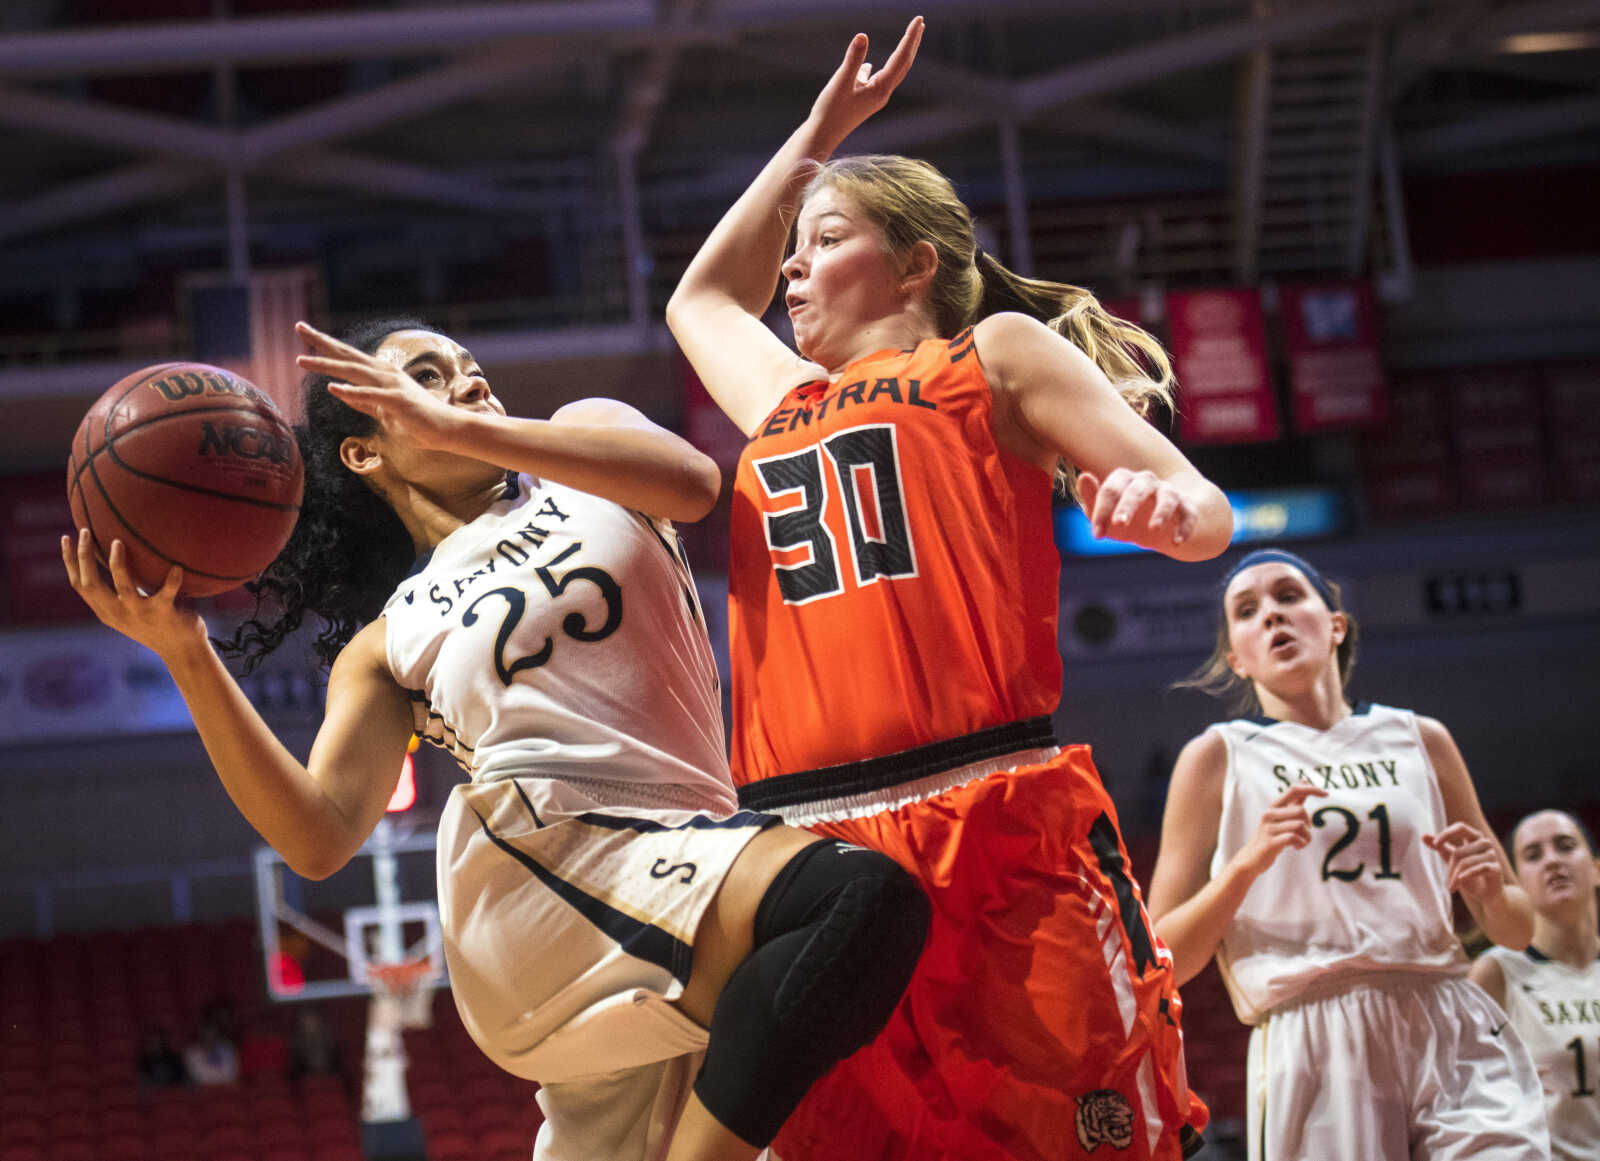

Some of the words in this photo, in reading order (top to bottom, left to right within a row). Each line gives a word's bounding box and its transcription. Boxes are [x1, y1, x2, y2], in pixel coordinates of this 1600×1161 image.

[149, 372, 270, 407] Wil
[749, 378, 936, 442] ENTRAL
[752, 424, 919, 606] 30
[462, 542, 623, 687] 25
[1273, 760, 1400, 793] SAXONY
[650, 858, 697, 884] S
[1312, 803, 1402, 882] 21
[1566, 1036, 1600, 1097] 1
